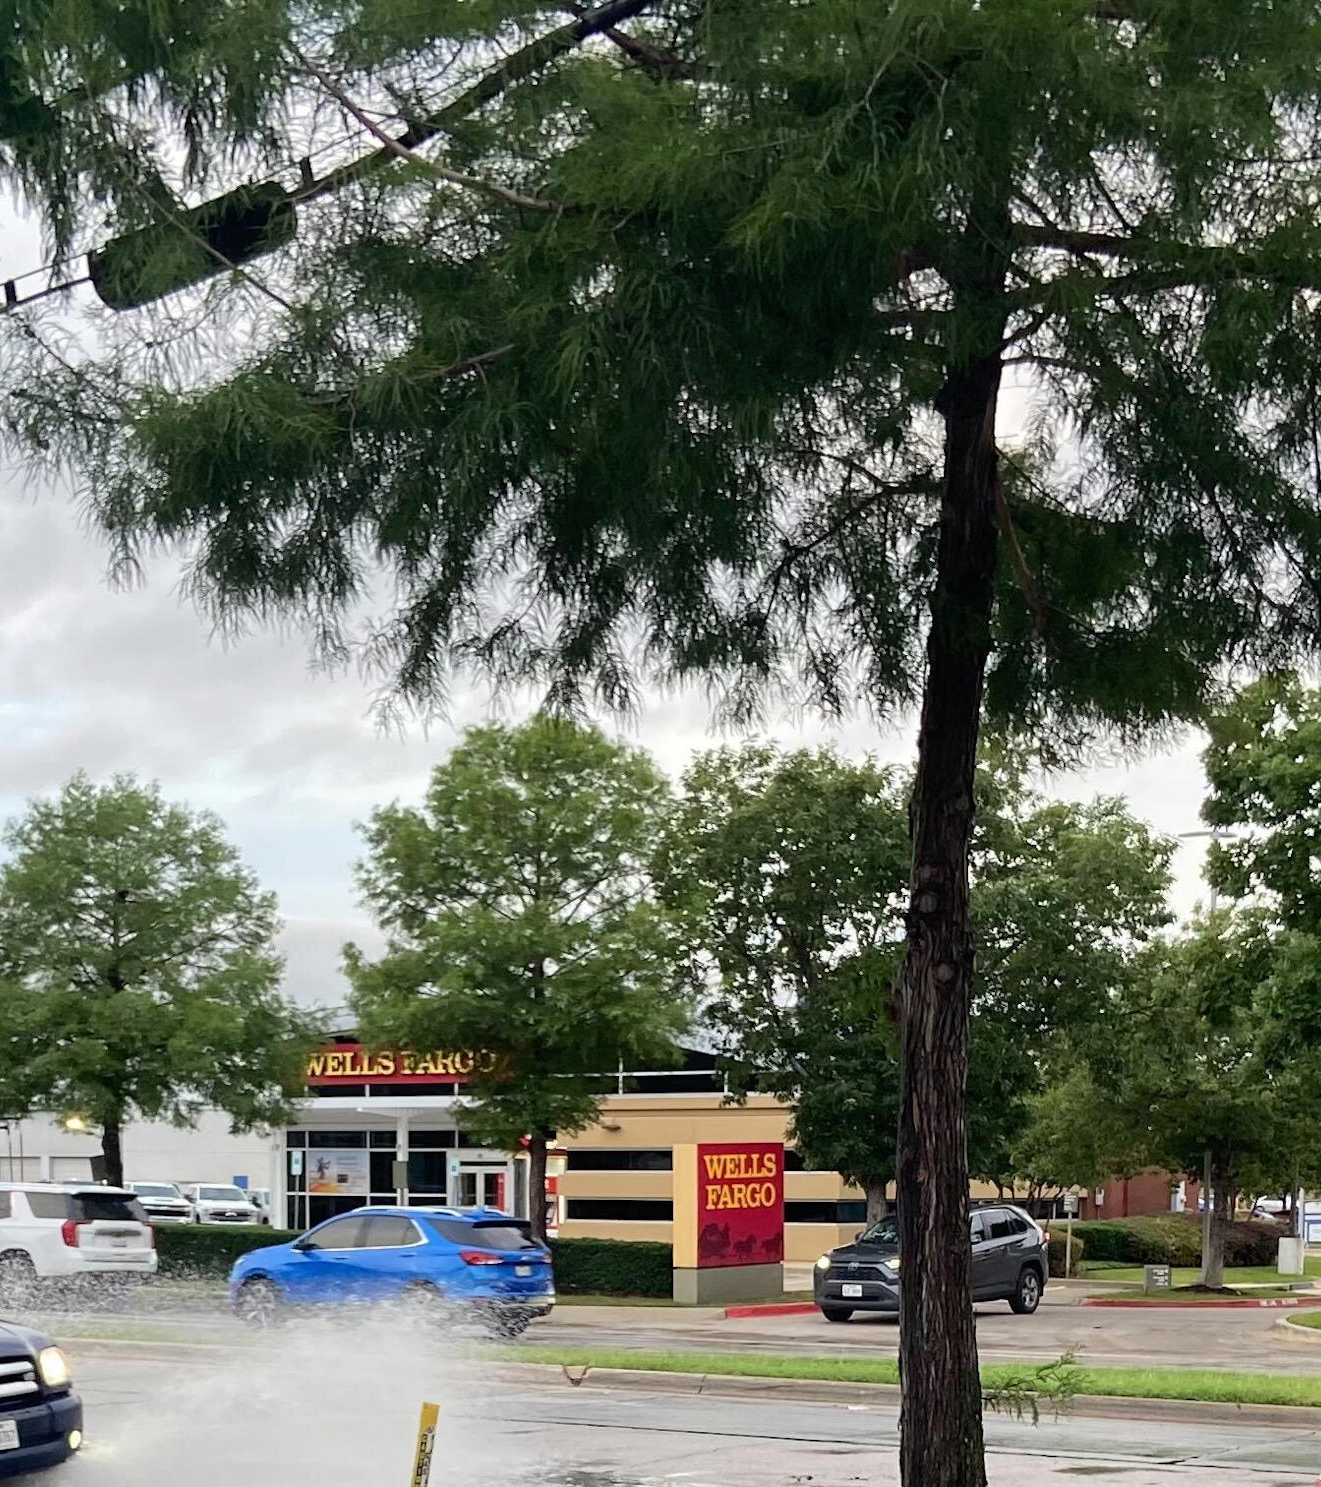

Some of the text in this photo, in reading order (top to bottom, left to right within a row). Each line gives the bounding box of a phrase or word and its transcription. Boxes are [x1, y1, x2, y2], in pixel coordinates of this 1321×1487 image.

[306, 1051, 396, 1077] WELLS
[703, 1152, 777, 1179] WELLS
[705, 1182, 777, 1210] FARGO
